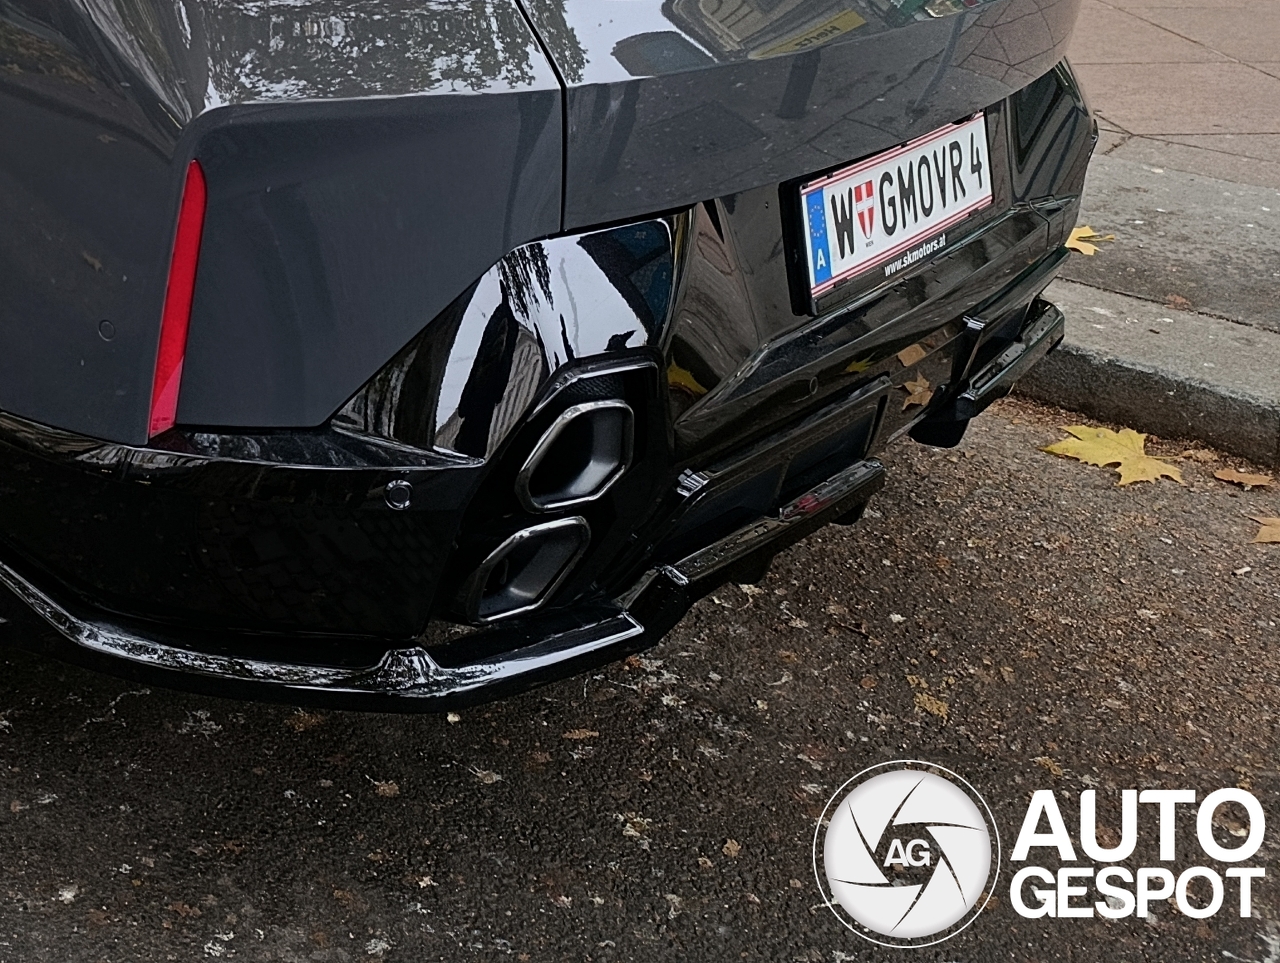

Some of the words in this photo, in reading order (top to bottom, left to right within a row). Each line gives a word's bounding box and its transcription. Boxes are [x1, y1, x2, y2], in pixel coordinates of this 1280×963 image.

[830, 186, 855, 260] W
[878, 140, 967, 237] GMOVR
[970, 132, 983, 189] 4
[816, 248, 826, 270] A
[884, 233, 947, 277] www.skmotors.at
